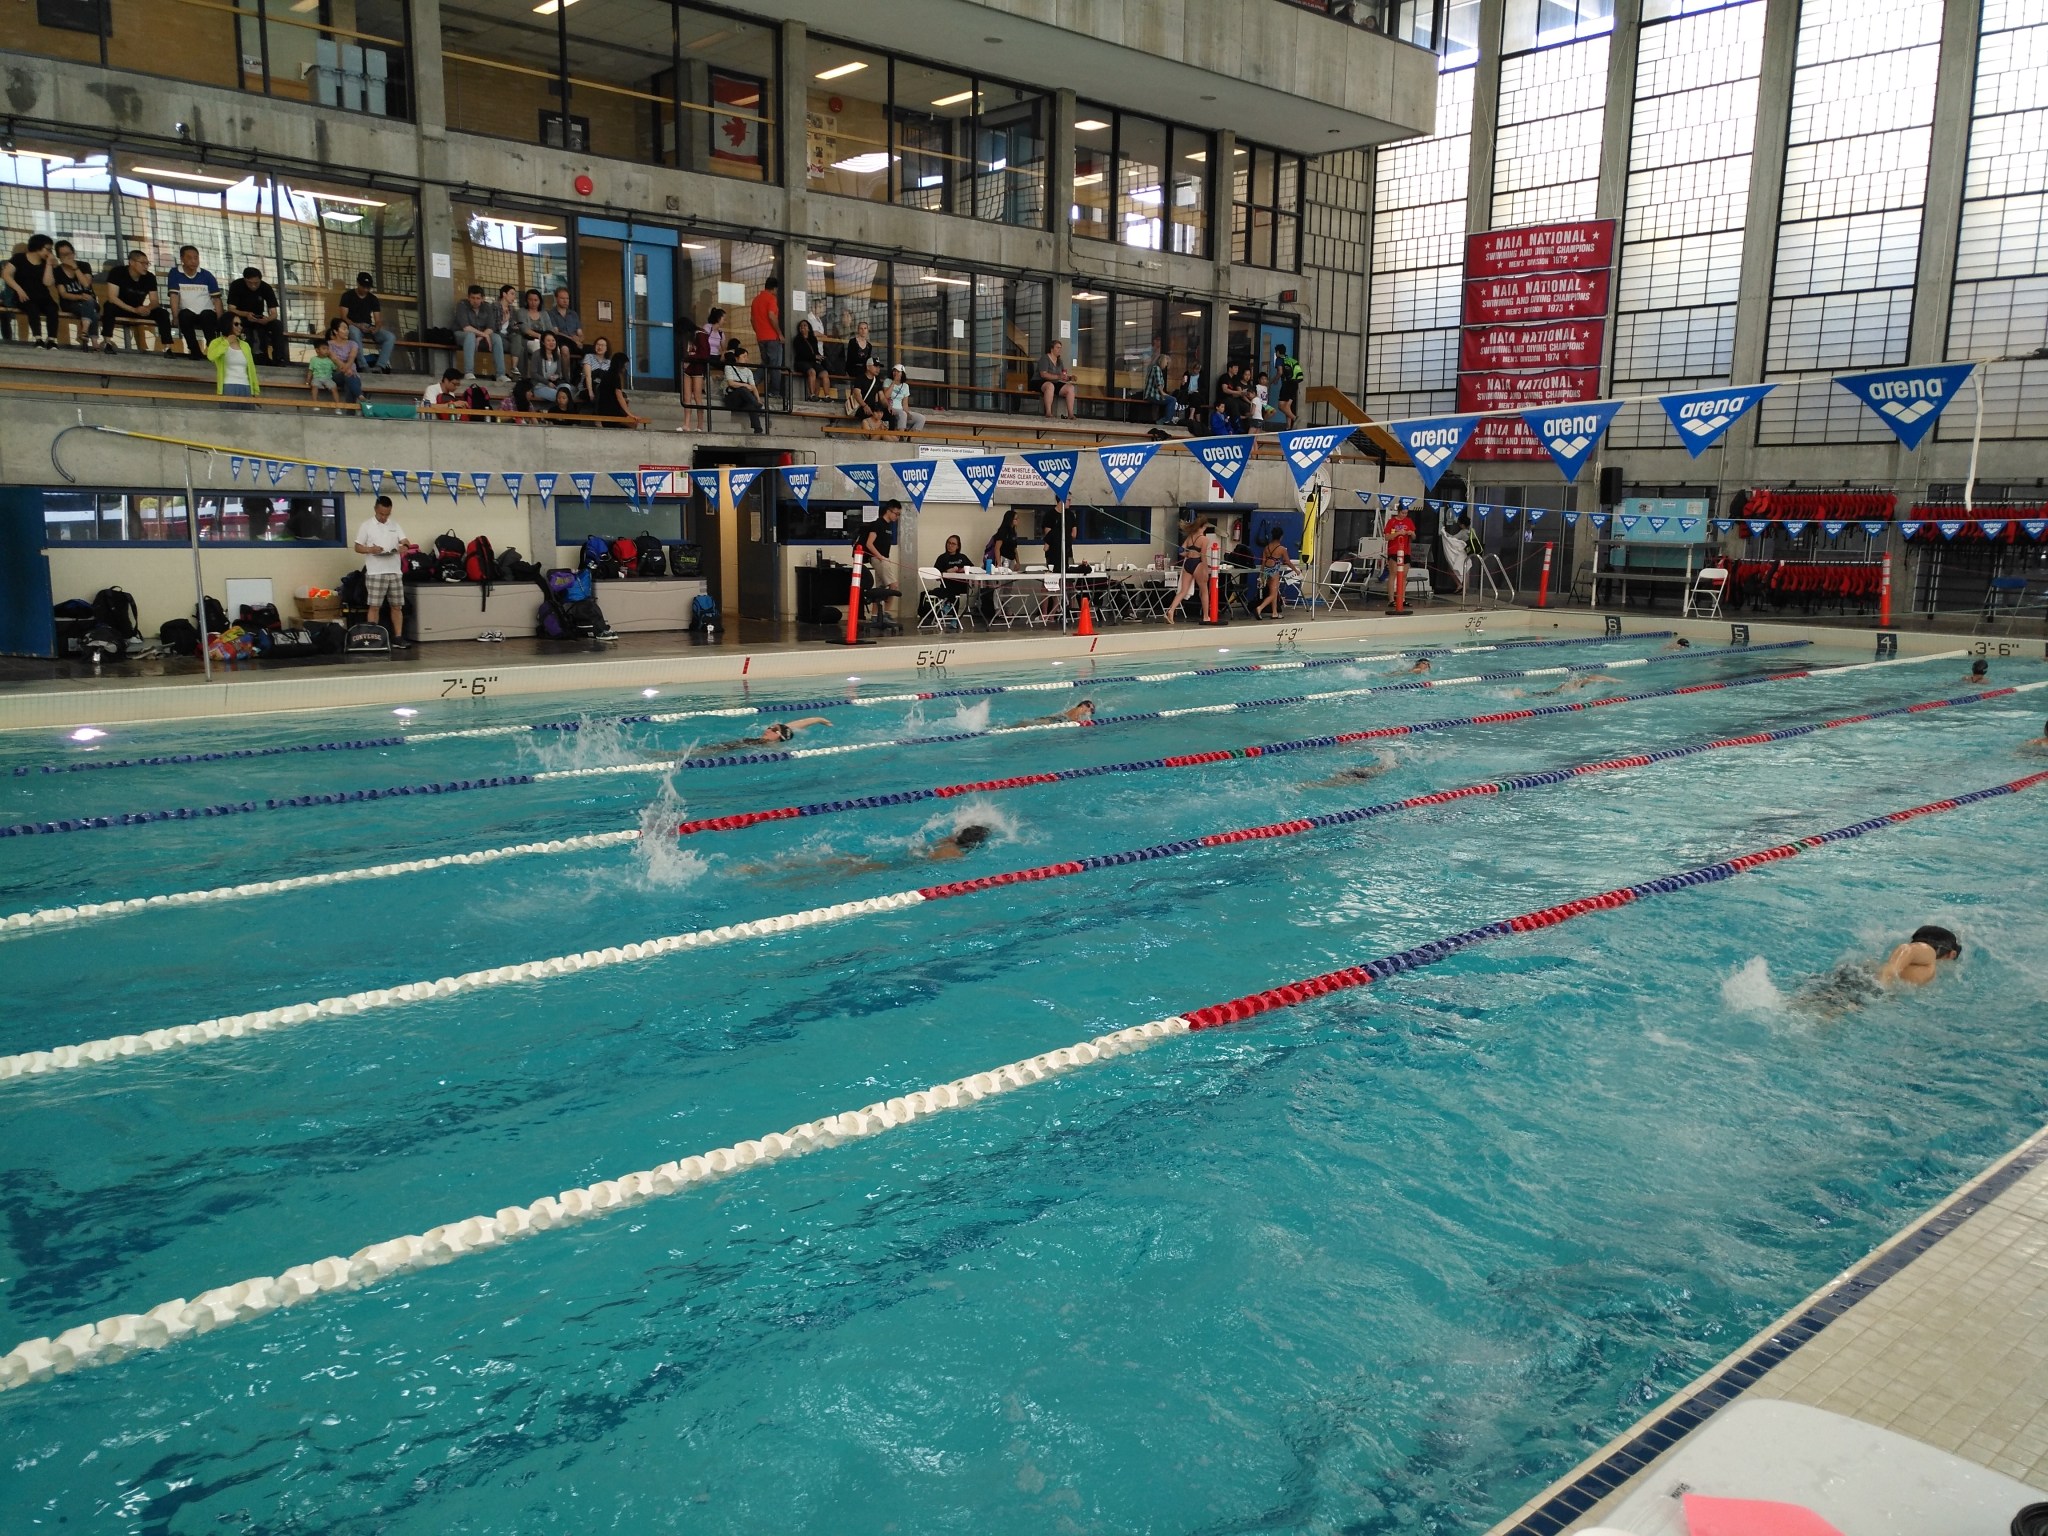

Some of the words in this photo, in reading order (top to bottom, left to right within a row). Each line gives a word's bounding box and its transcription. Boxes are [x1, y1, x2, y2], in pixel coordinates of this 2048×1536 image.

[1496, 236, 1522, 250] NAIA
[1530, 230, 1586, 246] NATIONAL
[1486, 250, 1517, 260] SWIMMING
[1520, 248, 1532, 257] AND
[1535, 246, 1554, 255] DIVING
[1557, 244, 1594, 253] CHAMPIONS
[1553, 256, 1567, 264] 1972
[1492, 284, 1518, 297] NAIA
[1526, 279, 1581, 293] NATIONAL
[1482, 297, 1513, 308] SWIMMING
[1516, 296, 1529, 304] AND
[1531, 294, 1551, 303] DIVING
[1554, 292, 1590, 302] CHAMPIONS
[1548, 304, 1563, 312] 1973
[1490, 332, 1515, 344] NAIA
[1522, 328, 1576, 343] NATIONAL
[1550, 342, 1584, 351] CHAMPIONS
[1545, 353, 1559, 361] 1974
[1487, 379, 1510, 390] NAIA
[1516, 376, 1572, 390] NATIONAL
[1869, 379, 1942, 400] arena
[1546, 390, 1580, 399] CHAMPIONS
[1680, 397, 1744, 418] arena
[1485, 424, 1508, 435] NAIA
[1544, 416, 1597, 436] arena
[1290, 435, 1334, 450] arena
[1411, 428, 1458, 447] arena
[1108, 453, 1144, 466] arena
[1203, 446, 1243, 461] arena
[1038, 456, 1071, 472] arena
[850, 470, 874, 480] arena
[902, 468, 928, 481] arena
[967, 465, 995, 478] arena
[698, 476, 716, 486] arena
[732, 474, 752, 483] arena
[789, 474, 809, 485] arena
[1608, 619, 1617, 630] 6
[1734, 627, 1744, 639] 5
[1881, 637, 1891, 650] 4
[1975, 642, 2019, 655] 3'-6"
[917, 650, 955, 665] 5'-0"
[441, 676, 497, 697] 7'-6"
